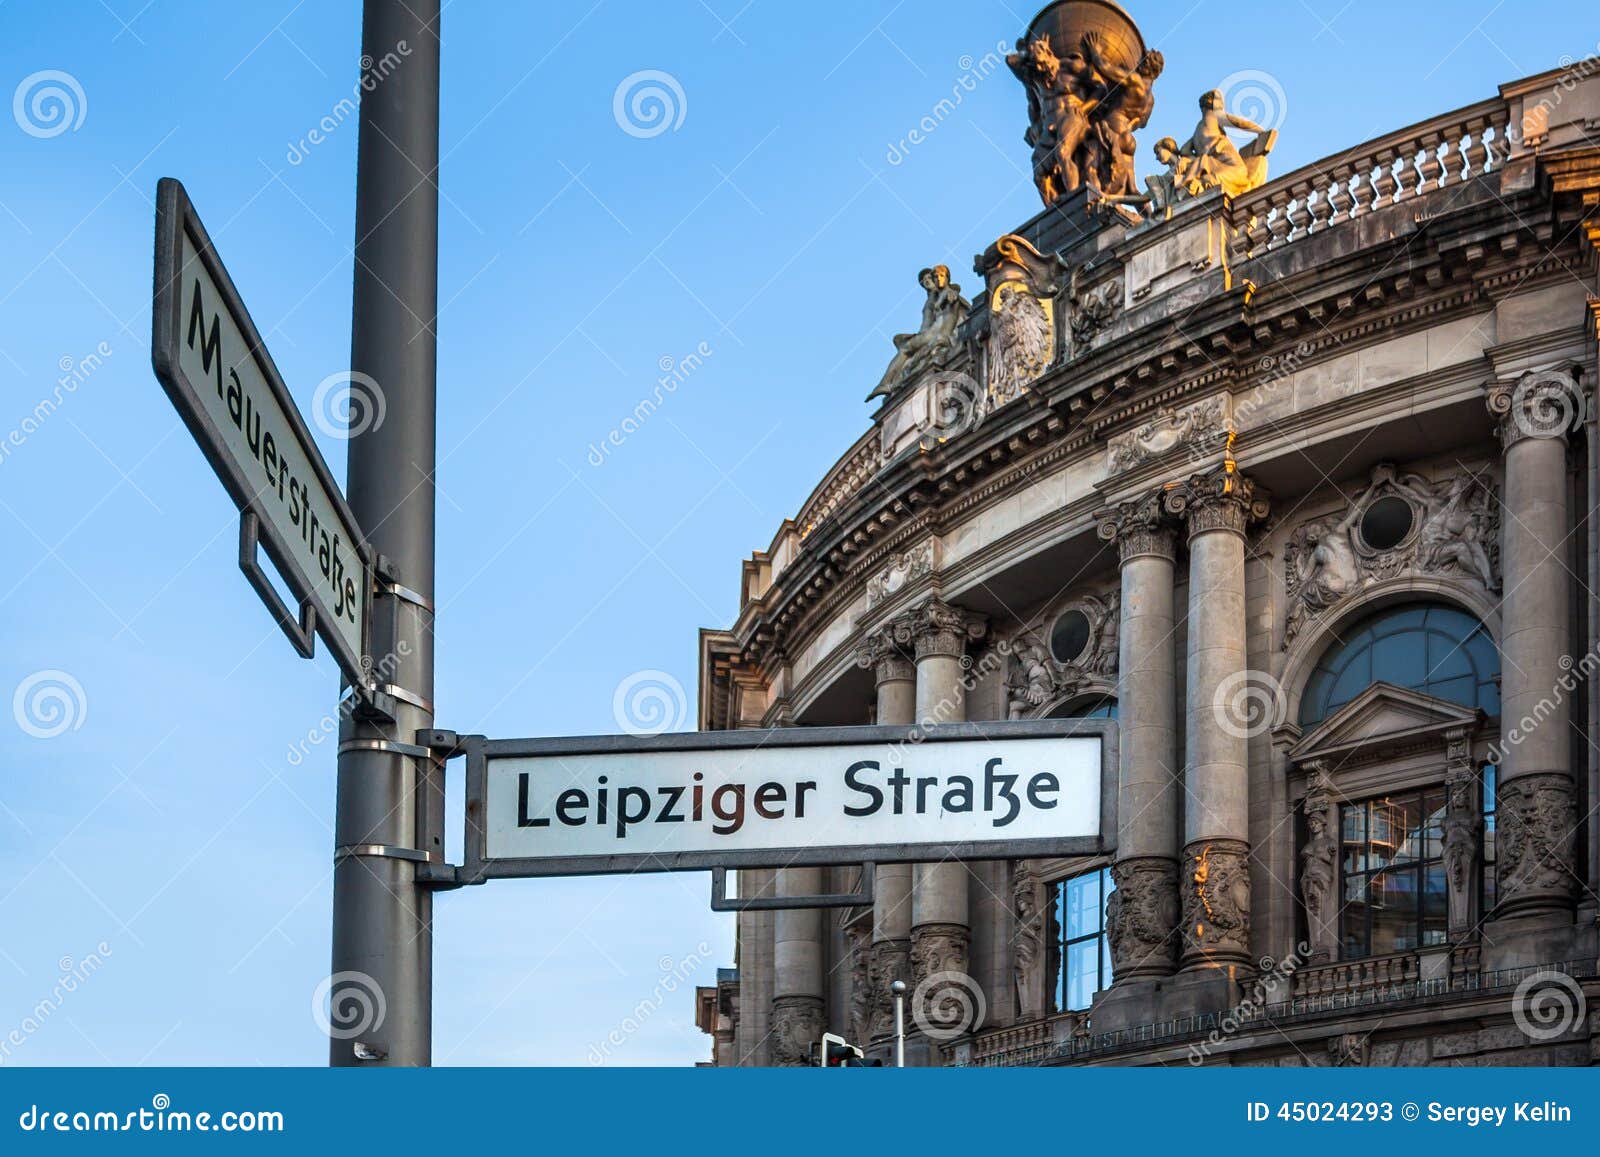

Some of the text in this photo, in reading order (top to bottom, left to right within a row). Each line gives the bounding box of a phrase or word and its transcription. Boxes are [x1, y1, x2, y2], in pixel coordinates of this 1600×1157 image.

[189, 279, 357, 624] Mauerstraße
[517, 757, 1060, 838] Leipziger Straße
